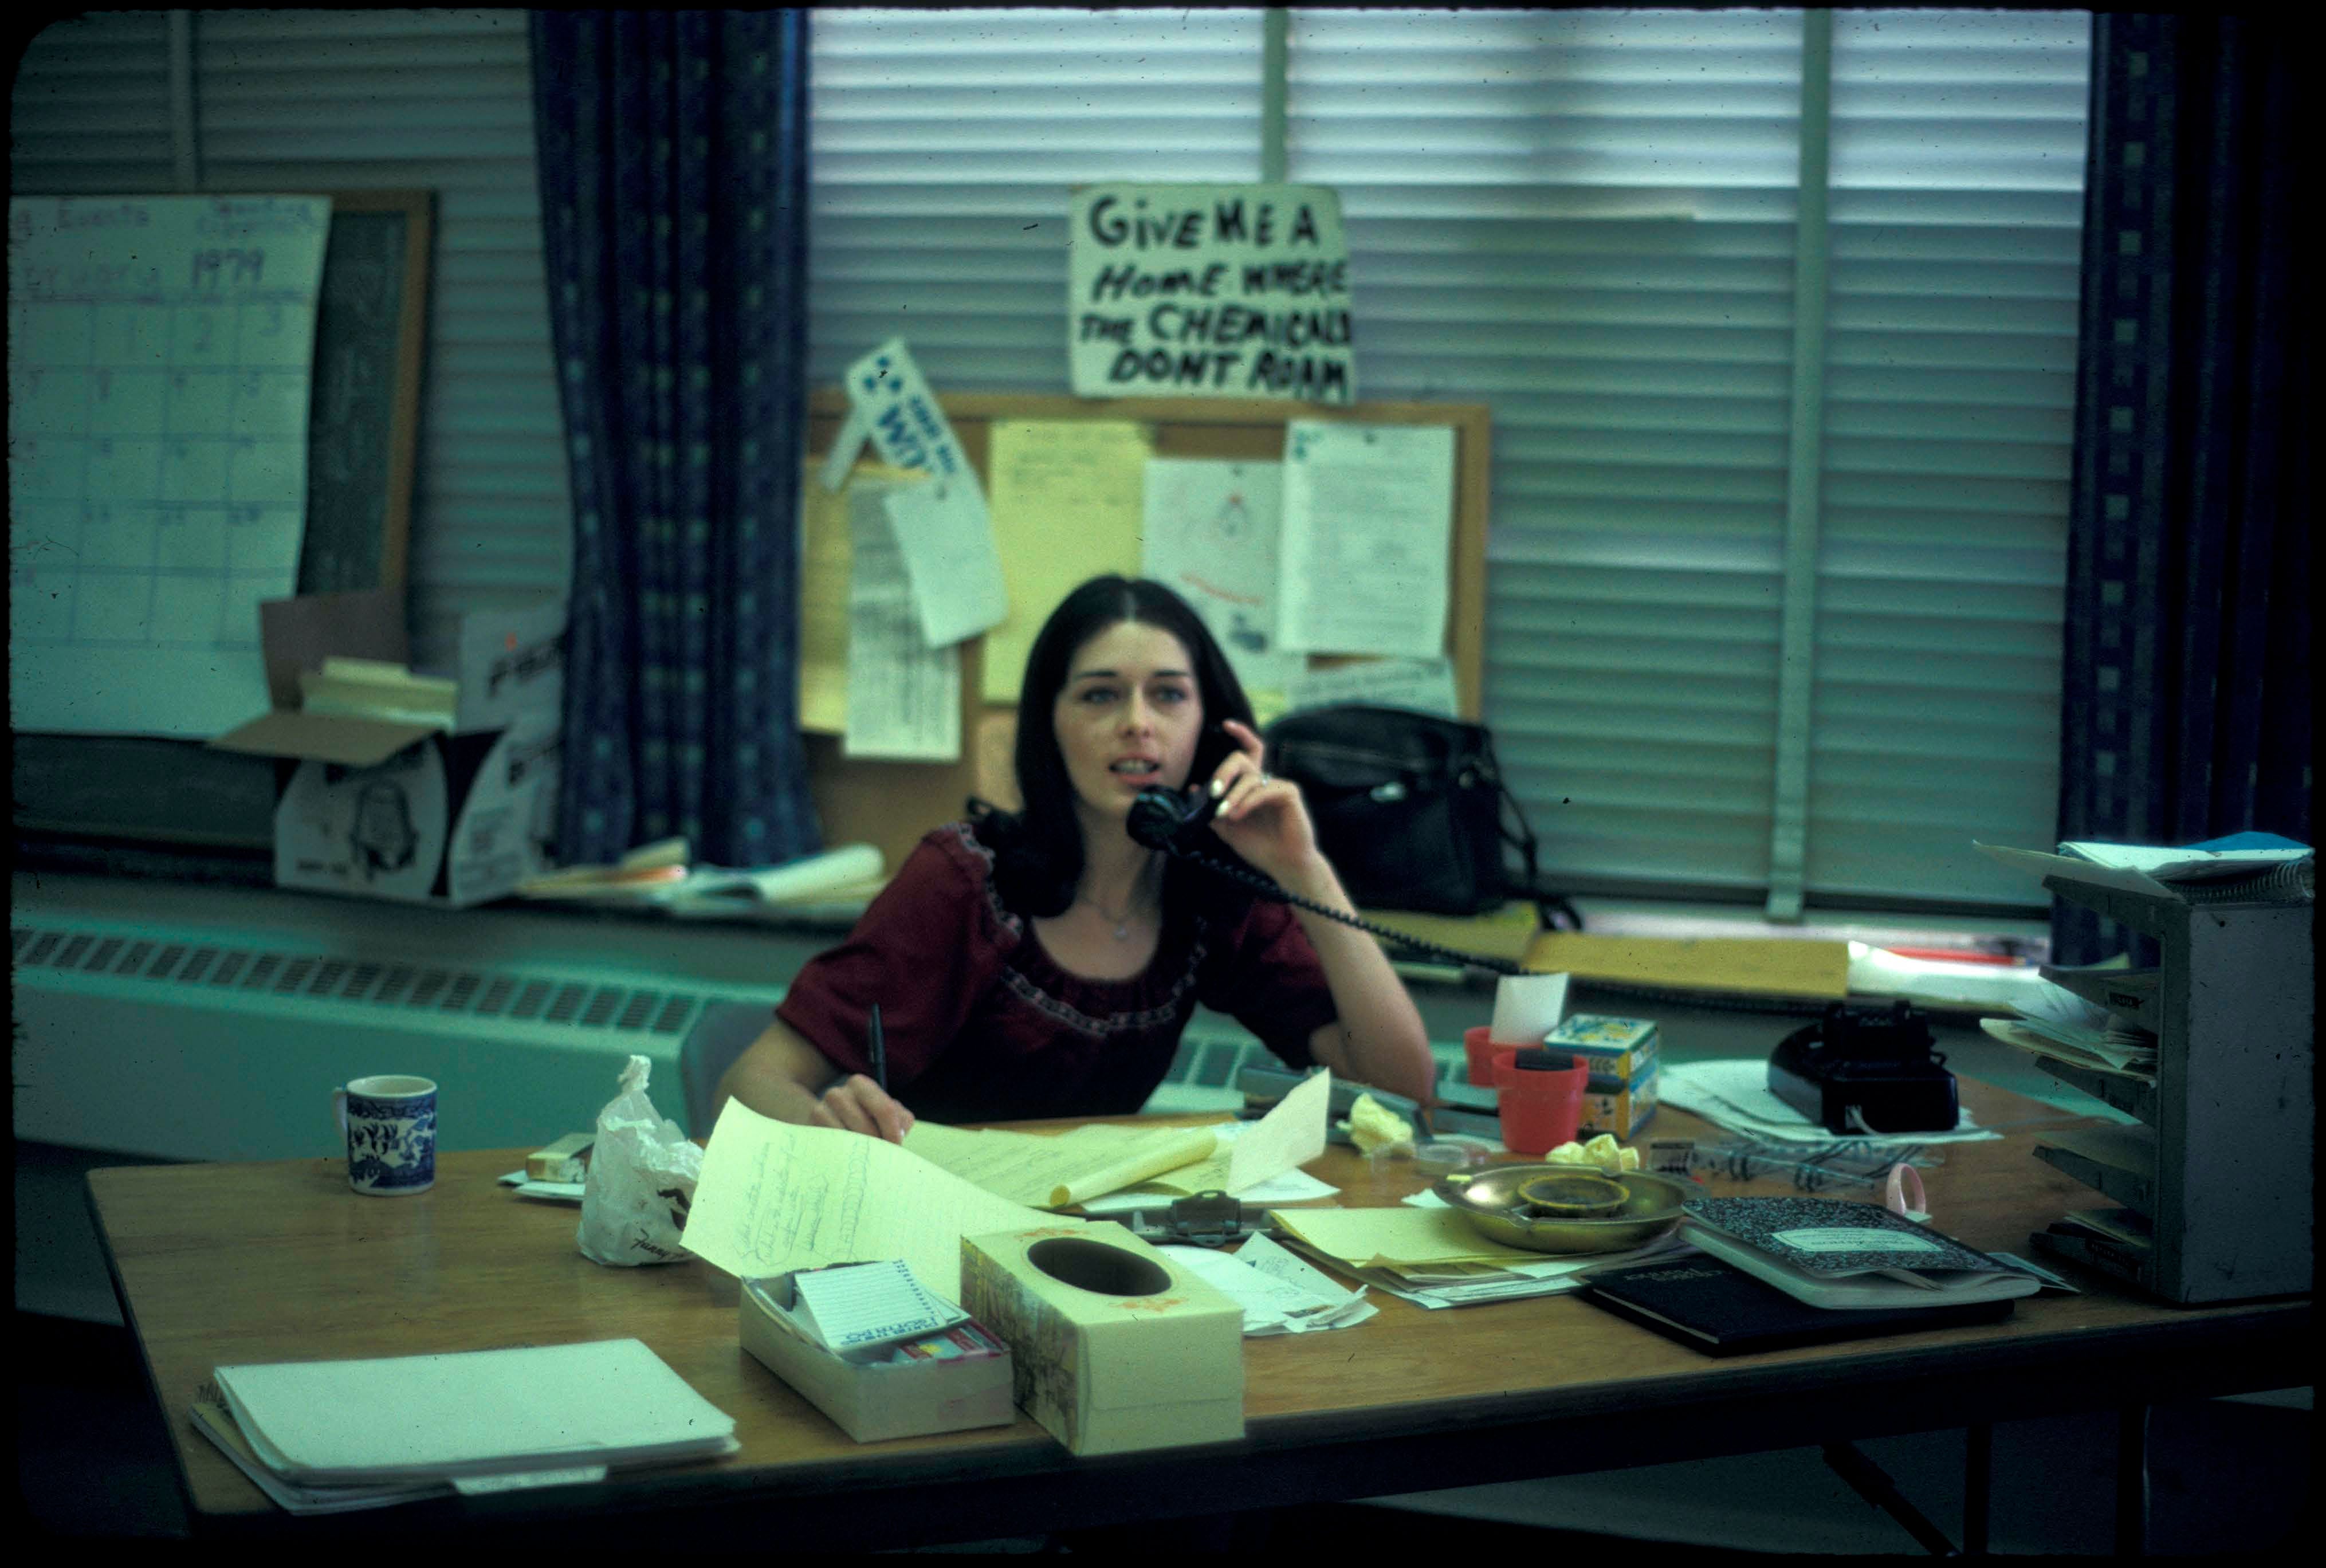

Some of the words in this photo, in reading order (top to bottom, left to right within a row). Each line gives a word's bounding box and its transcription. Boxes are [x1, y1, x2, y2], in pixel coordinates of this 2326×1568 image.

[1215, 197, 1274, 247] ME
[1290, 203, 1320, 246] A
[192, 246, 266, 289] 1979
[1241, 258, 1349, 298] WHERE
[194, 312, 212, 352] 2
[1081, 313, 1134, 344] THE
[1109, 348, 1242, 386] DONT
[1247, 350, 1348, 400] ROAM
